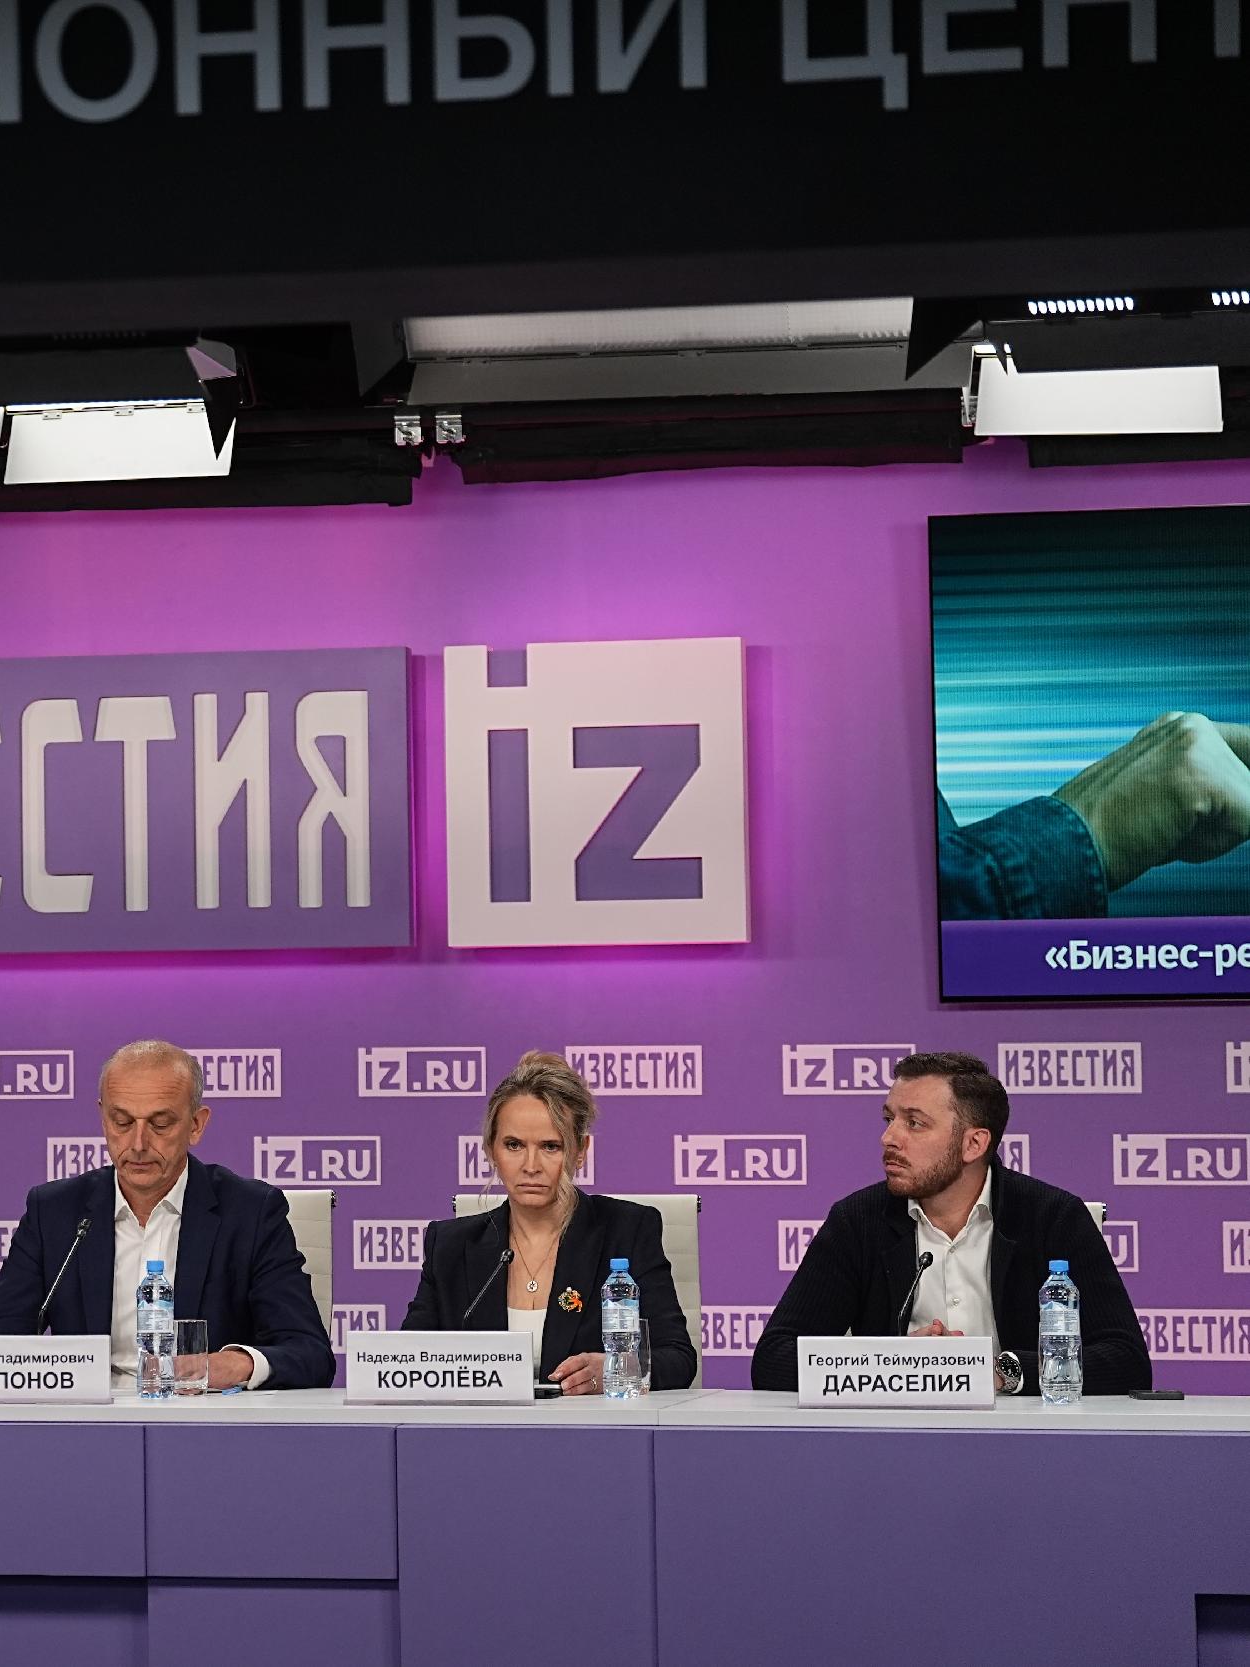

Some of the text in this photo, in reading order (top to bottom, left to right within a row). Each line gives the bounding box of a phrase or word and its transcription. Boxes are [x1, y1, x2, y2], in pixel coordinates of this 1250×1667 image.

[191, 1055, 275, 1091] ЕСТИЯ
[1005, 1049, 1136, 1088] ИЗВЕСТИЯ
[357, 1351, 523, 1366] Надежда Владимировна
[808, 1353, 985, 1369] Георгий Теймуразович
[377, 1365, 503, 1389] КОРОЛЁВА
[822, 1374, 971, 1396] ДАРАСЕЛИЯ
